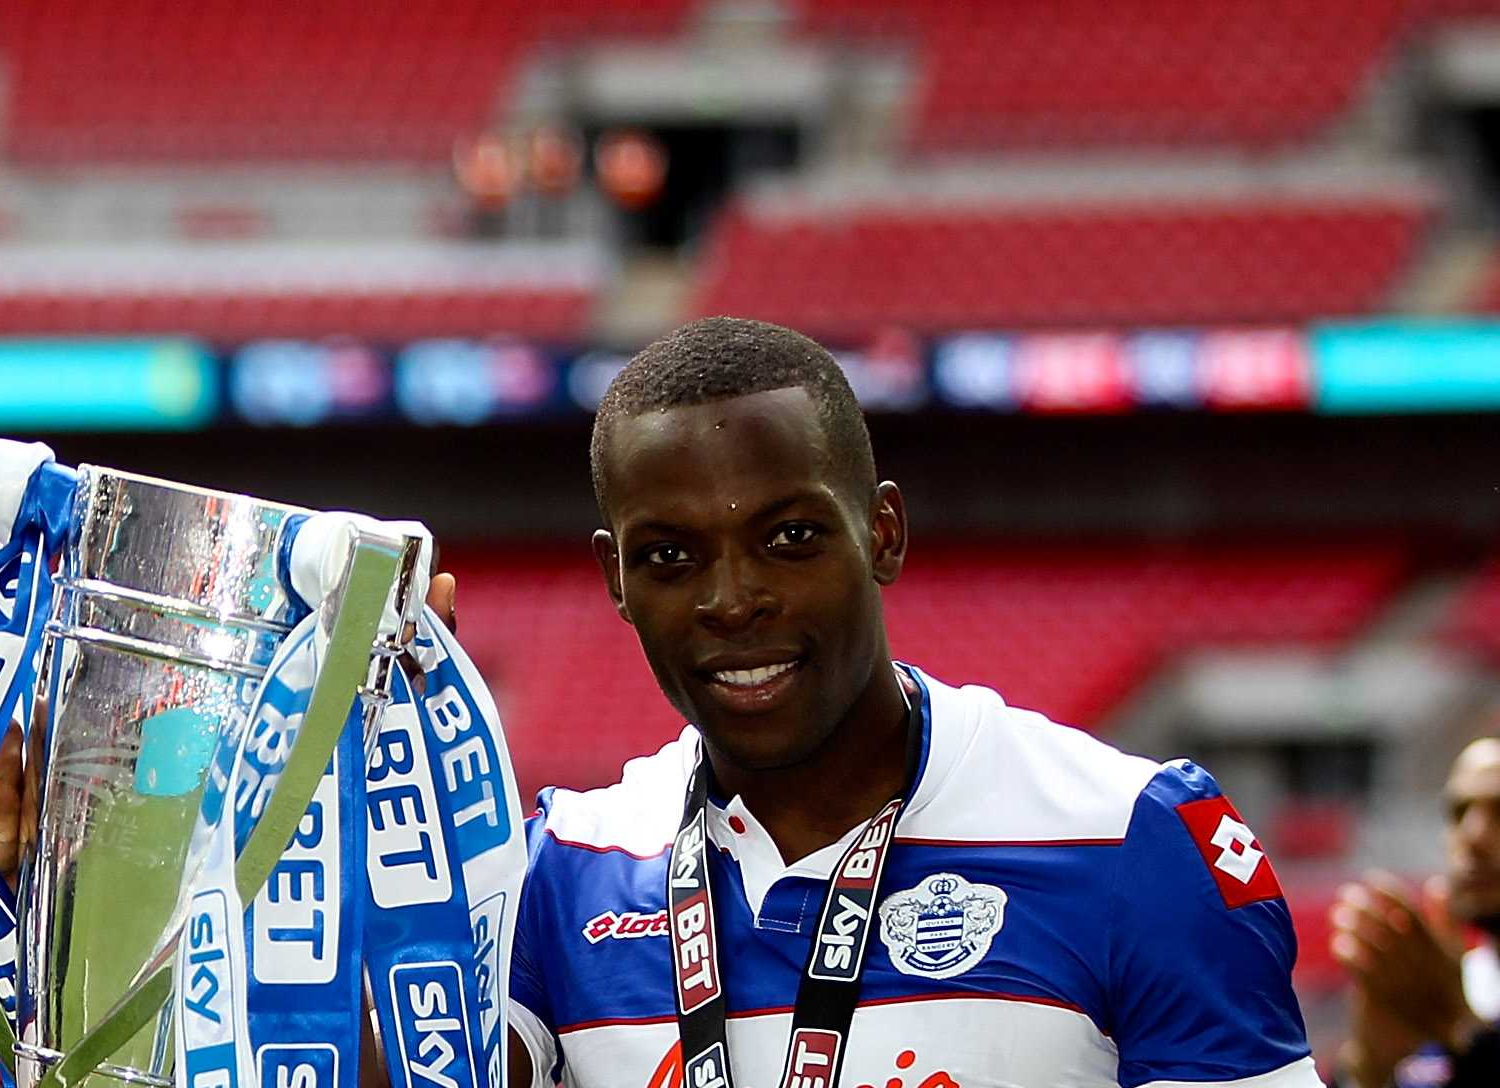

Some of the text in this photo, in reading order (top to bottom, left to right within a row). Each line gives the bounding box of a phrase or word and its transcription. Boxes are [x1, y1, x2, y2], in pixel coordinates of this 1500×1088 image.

[367, 728, 438, 881] BET
[425, 685, 498, 827] BET
[185, 914, 226, 1024] sky
[672, 825, 714, 990] sky BET
[821, 895, 868, 970] sky
